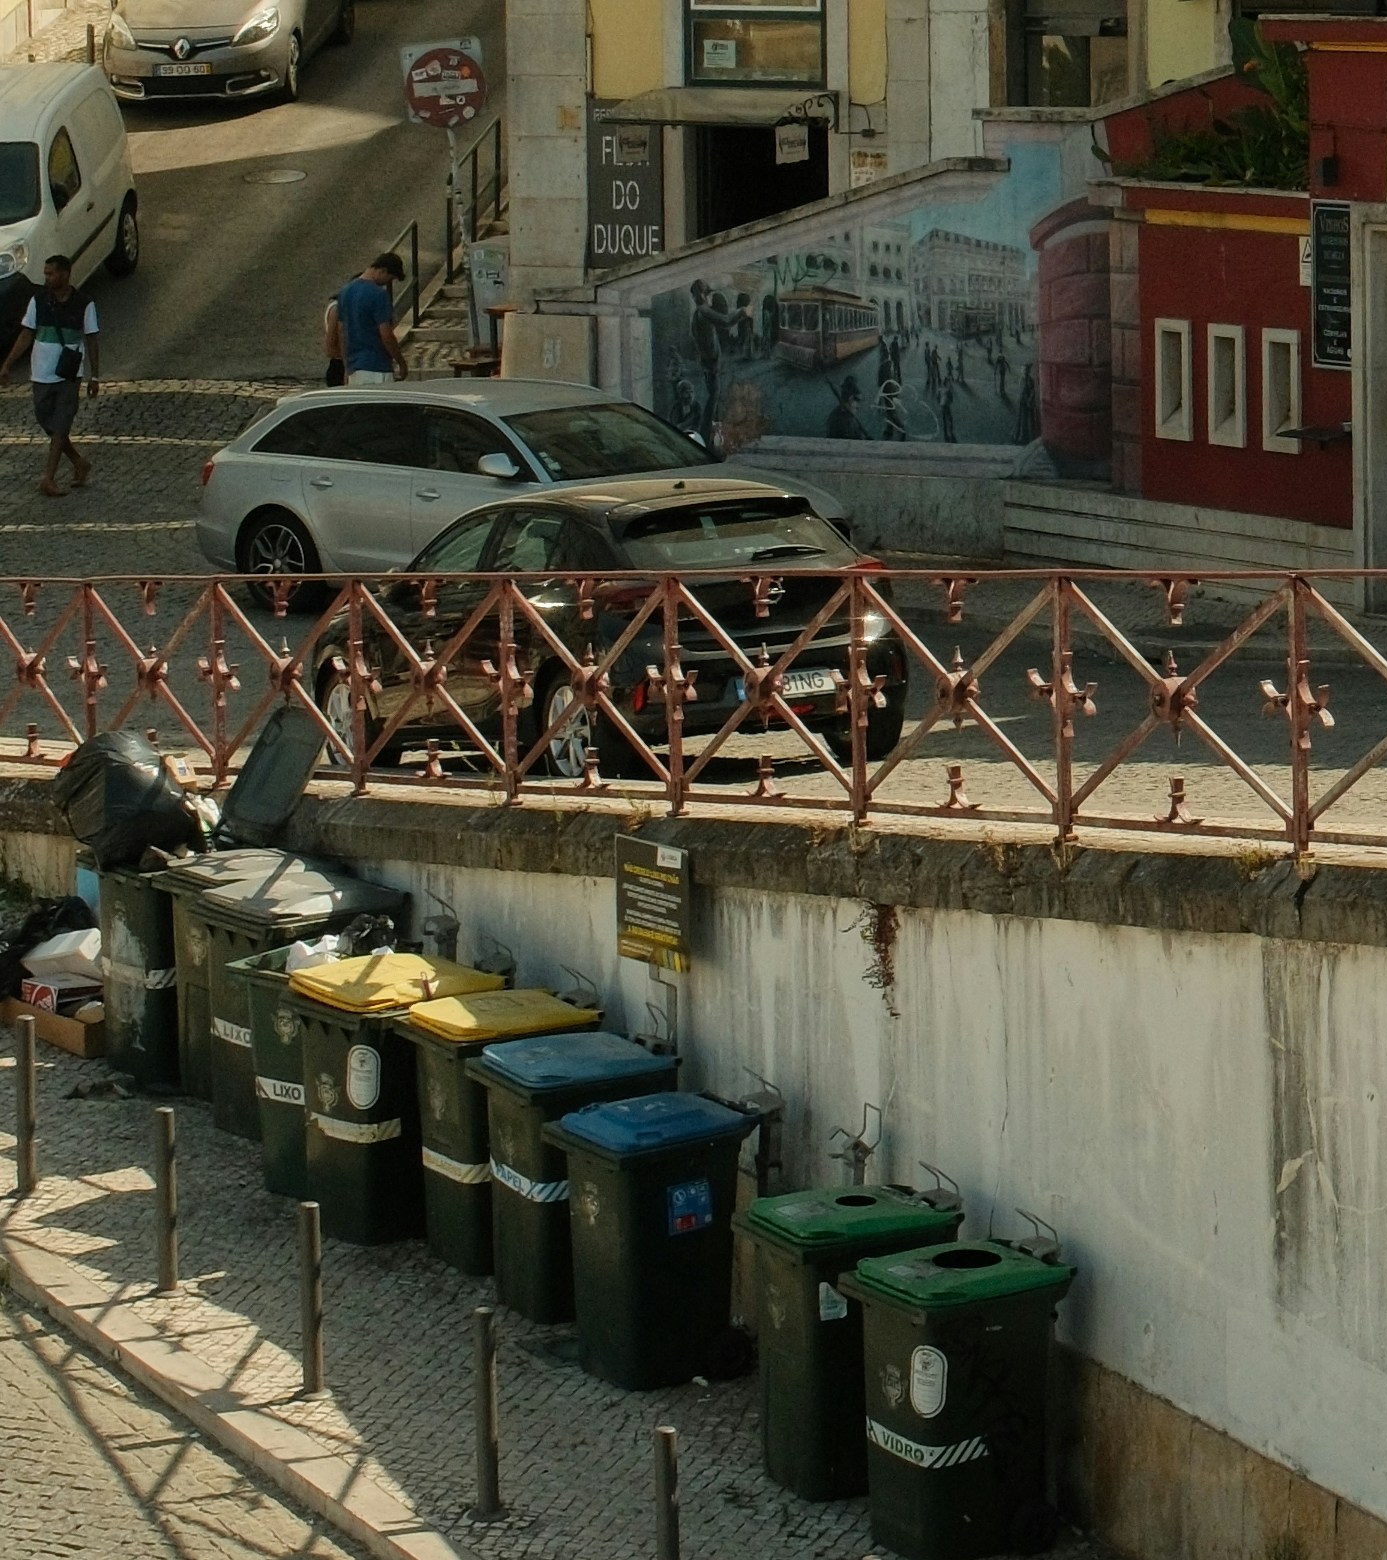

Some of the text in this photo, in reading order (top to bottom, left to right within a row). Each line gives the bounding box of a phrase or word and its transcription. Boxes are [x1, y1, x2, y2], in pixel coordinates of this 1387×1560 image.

[612, 180, 640, 210] DO
[594, 224, 659, 256] DUQUE
[272, 1082, 302, 1101] LIXO
[881, 1431, 925, 1463] VIDRO
